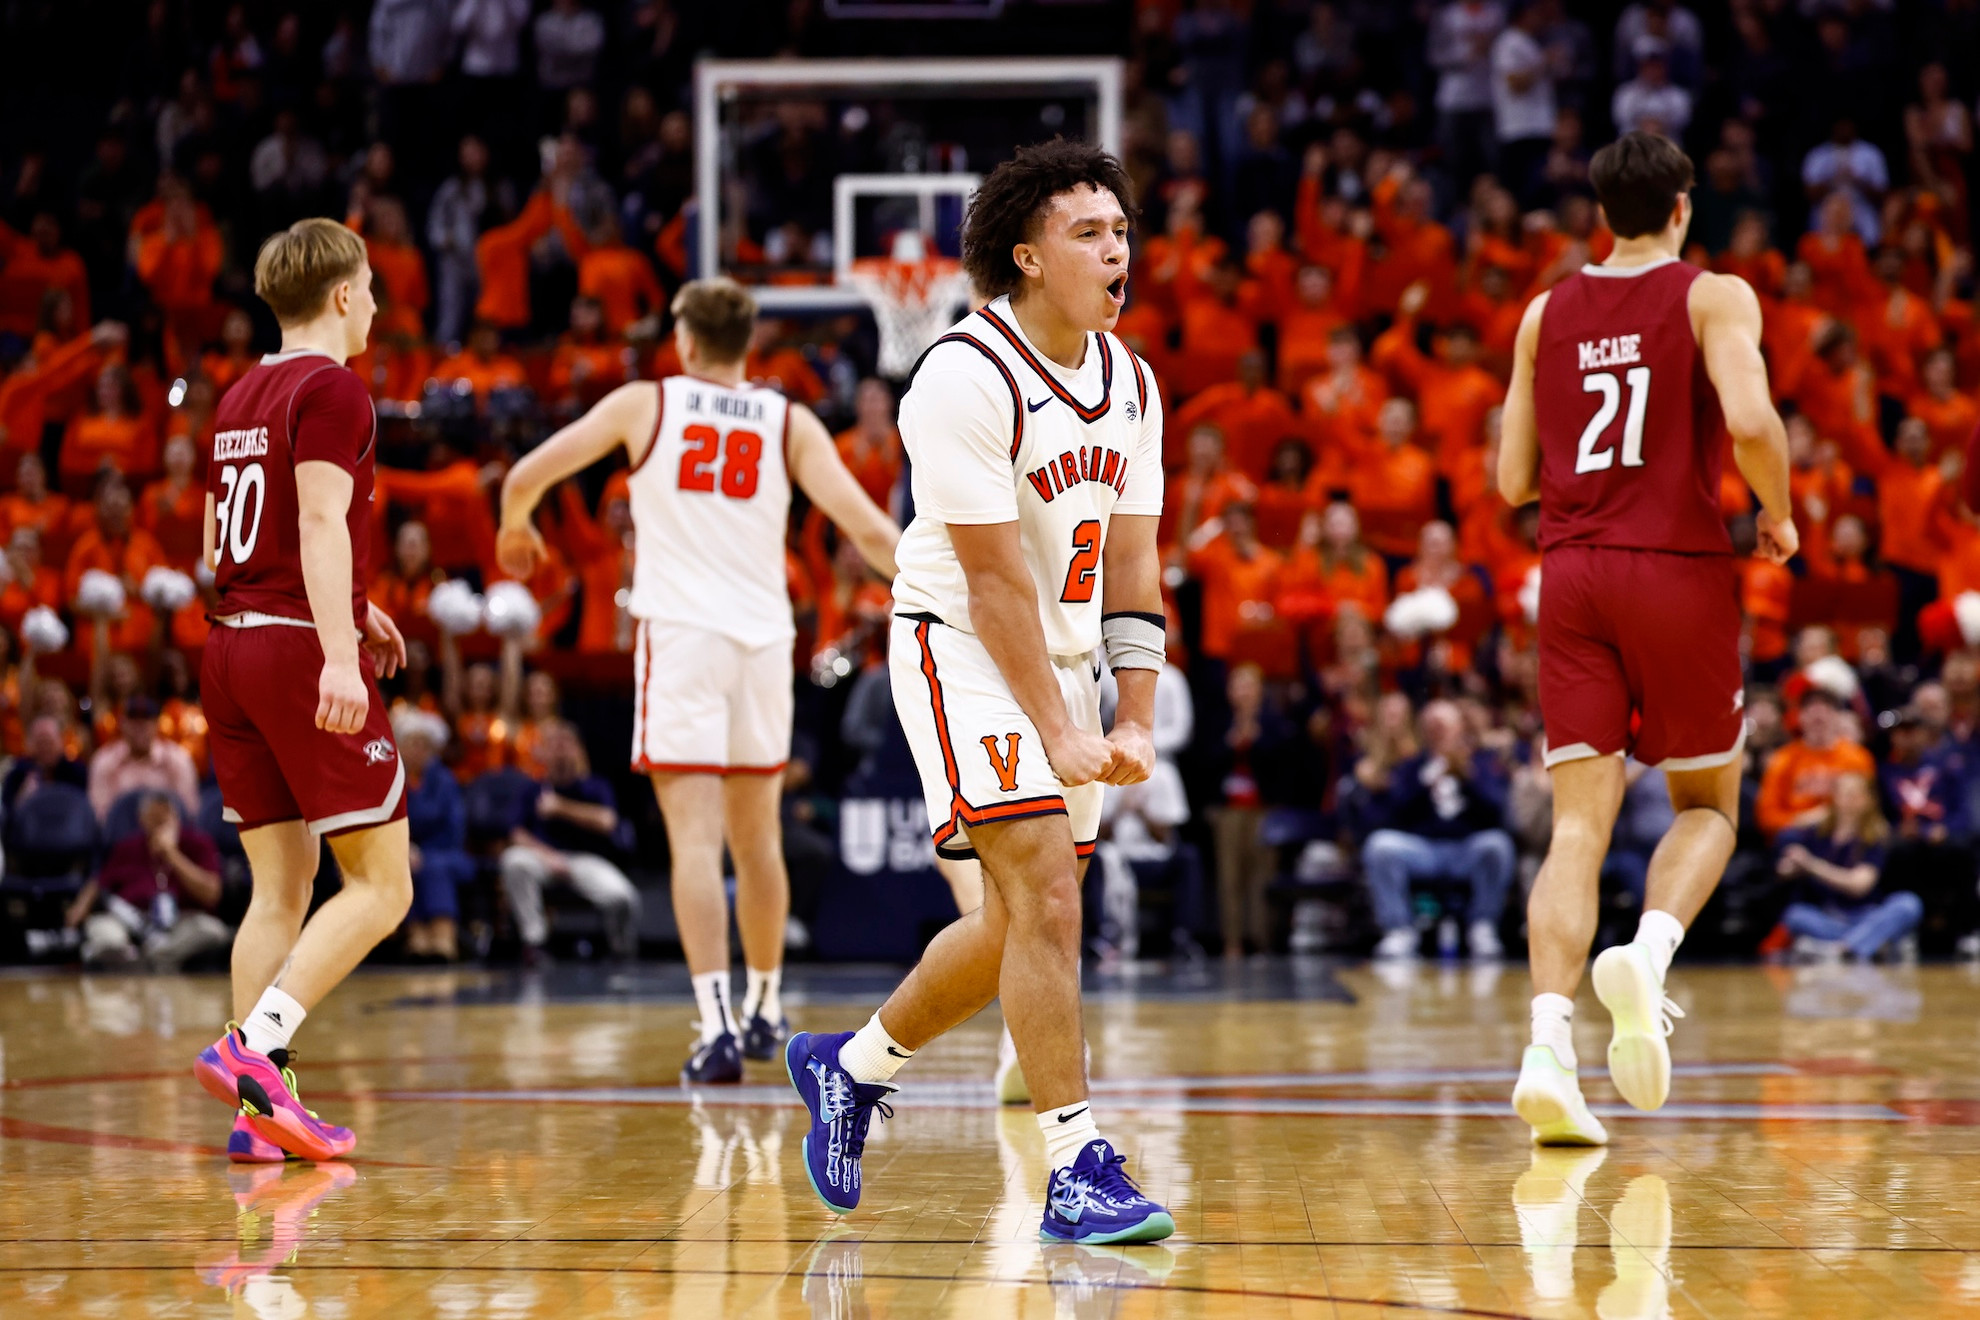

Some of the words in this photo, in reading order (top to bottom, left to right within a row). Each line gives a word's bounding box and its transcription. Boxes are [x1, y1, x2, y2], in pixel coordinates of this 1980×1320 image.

[1578, 333, 1641, 370] McCABE
[677, 422, 763, 499] 28
[1574, 366, 1651, 475] 21
[214, 462, 266, 567] 30
[1059, 519, 1101, 603] 2
[979, 732, 1022, 792] V
